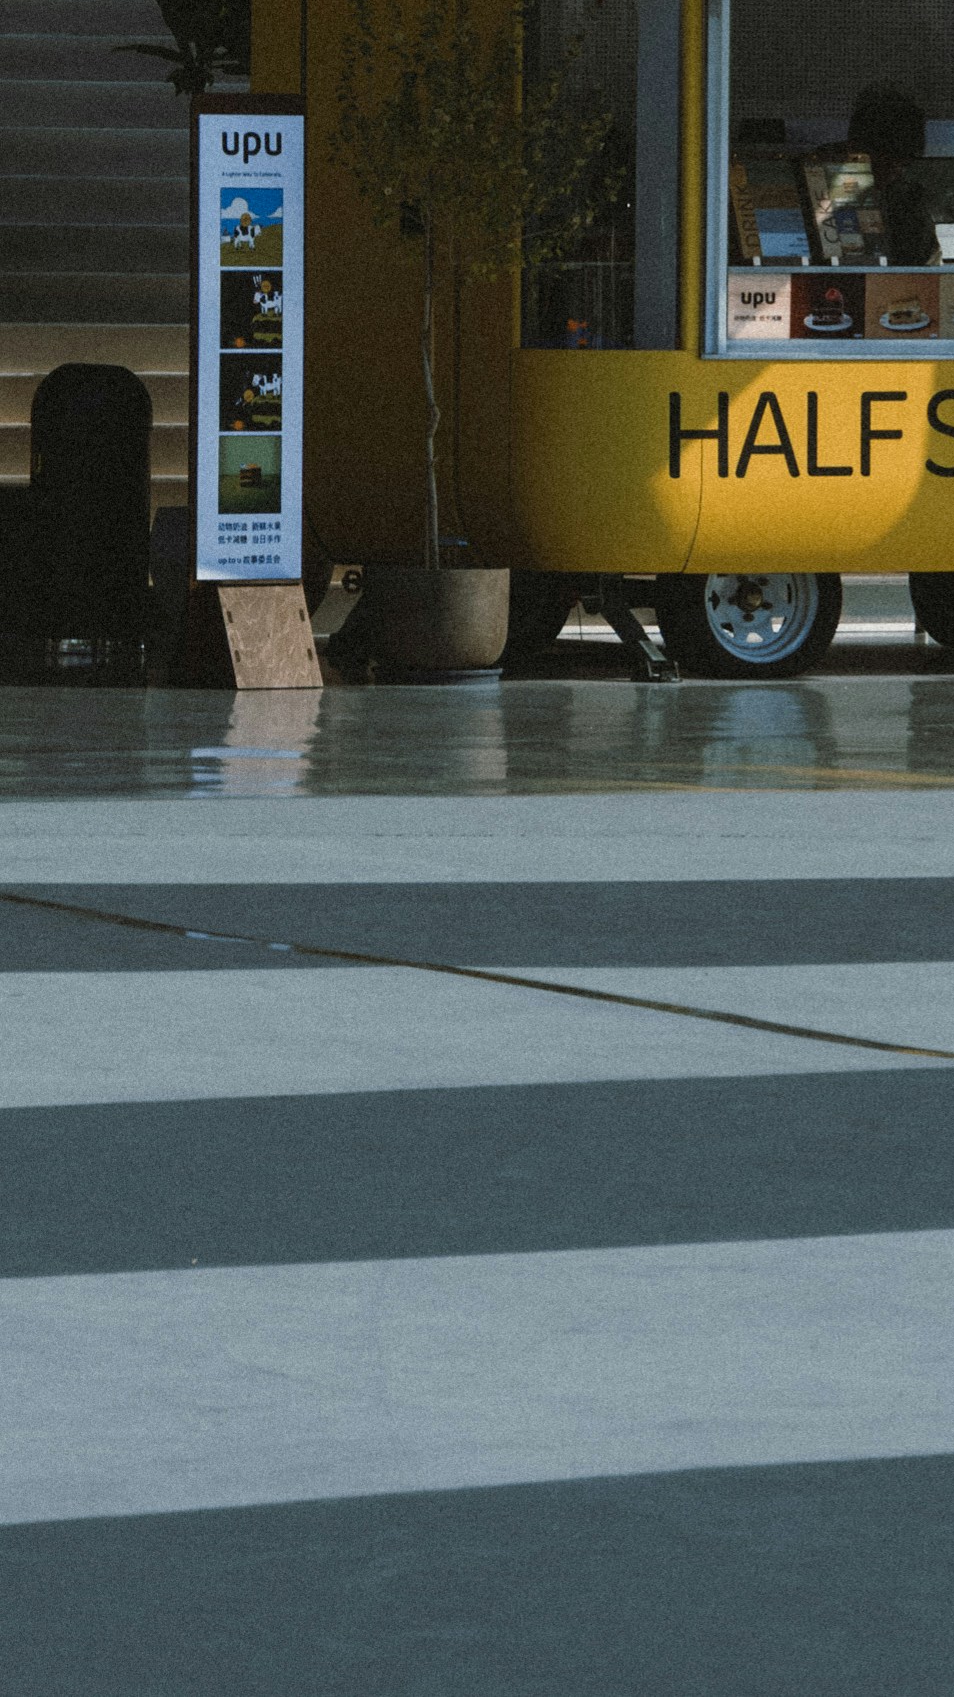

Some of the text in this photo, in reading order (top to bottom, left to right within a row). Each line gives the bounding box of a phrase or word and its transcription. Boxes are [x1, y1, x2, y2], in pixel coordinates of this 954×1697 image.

[222, 131, 282, 164] upu
[737, 184, 759, 248] DRINK
[814, 189, 841, 245] CAKE
[741, 292, 776, 309] upu
[669, 391, 907, 478] HALF
